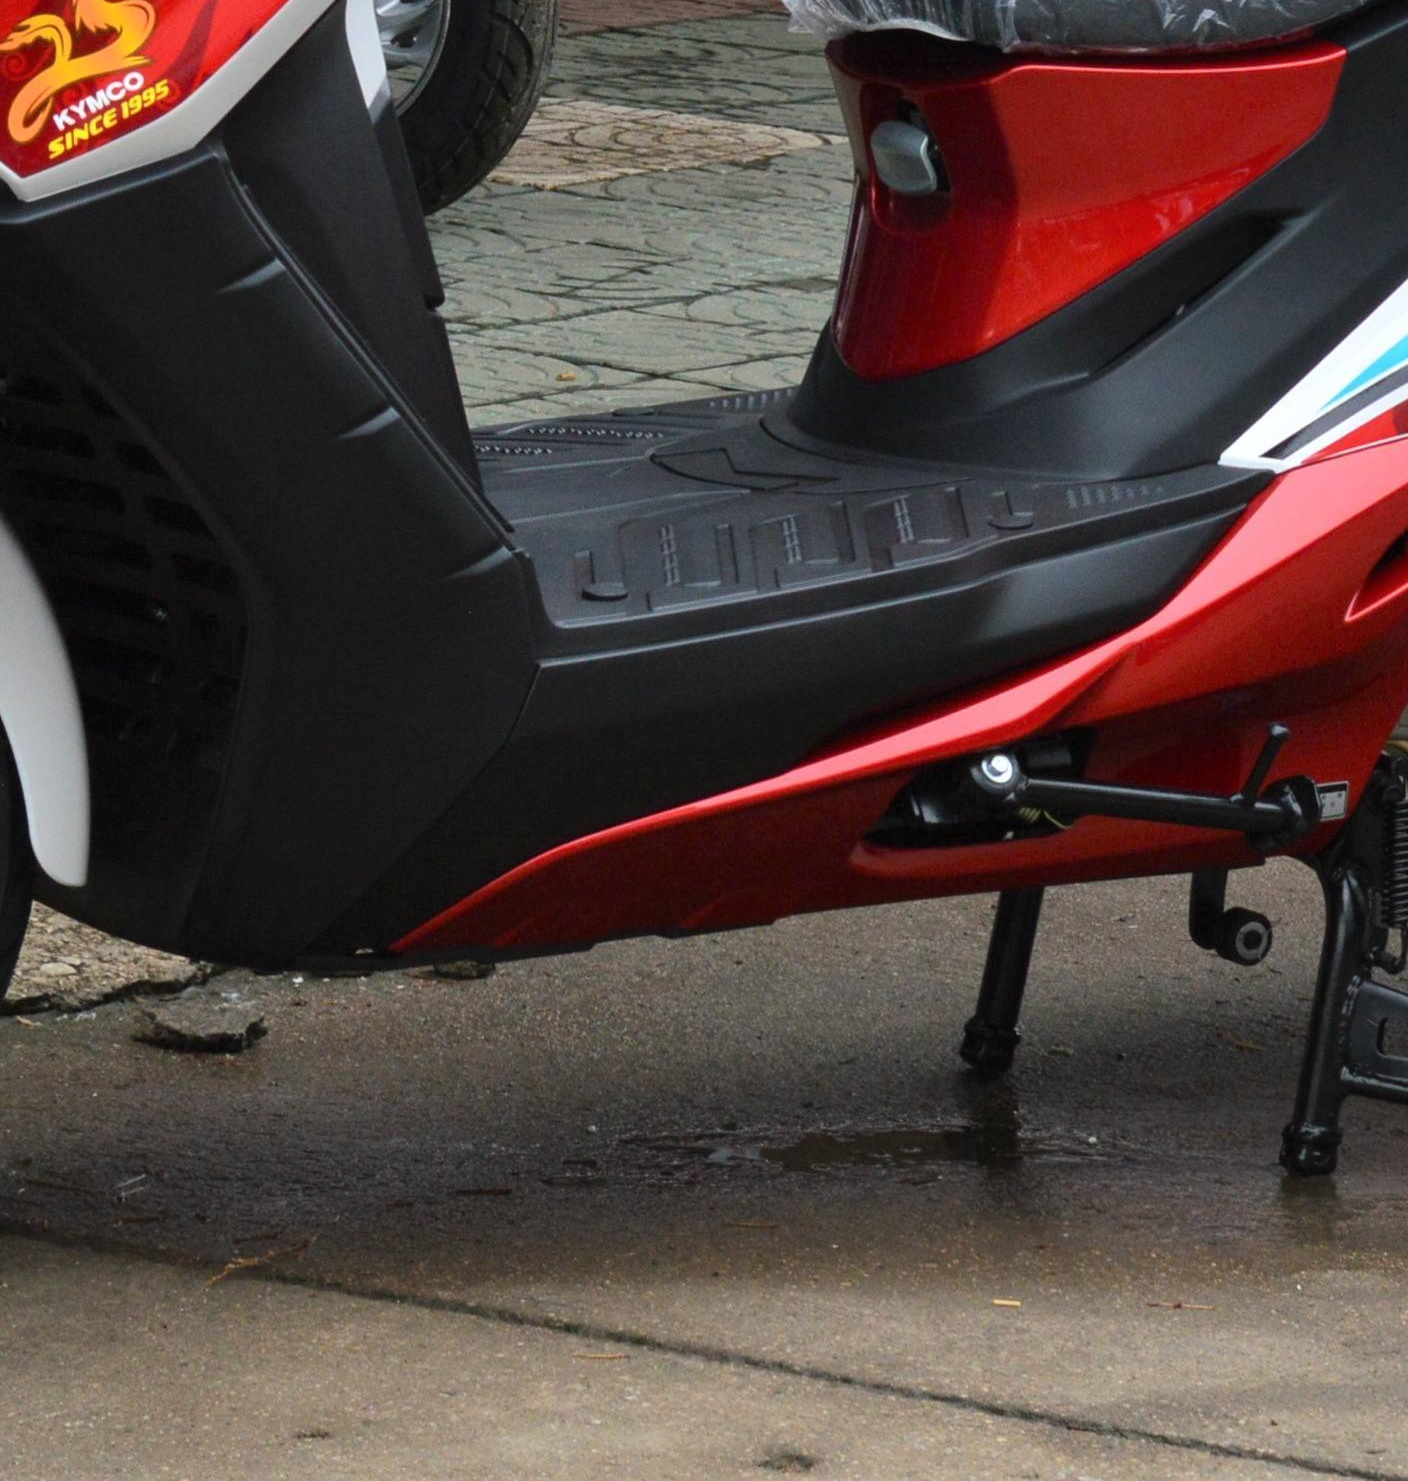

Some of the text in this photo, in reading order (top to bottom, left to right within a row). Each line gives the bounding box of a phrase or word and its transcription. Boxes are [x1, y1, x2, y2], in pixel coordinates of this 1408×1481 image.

[48, 78, 170, 159] SINCE 1995
[52, 71, 145, 132] KYMCO
